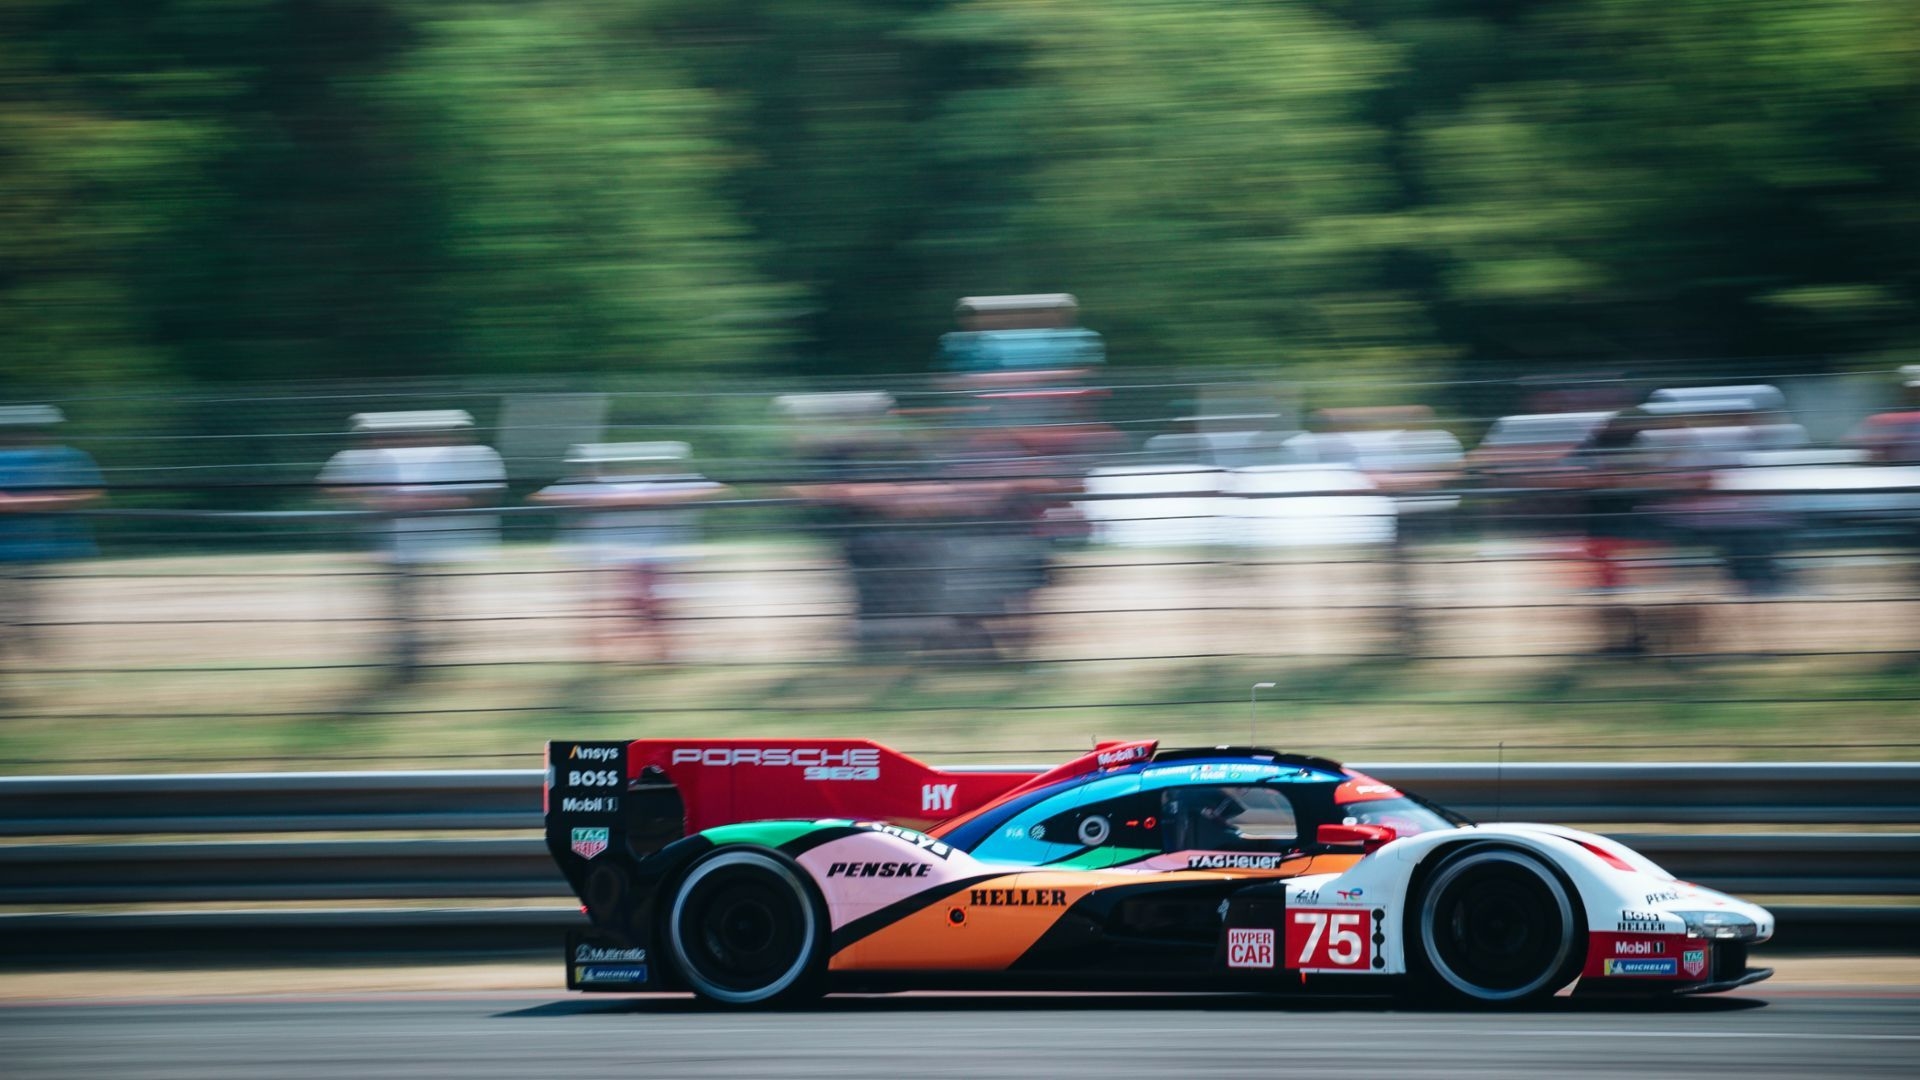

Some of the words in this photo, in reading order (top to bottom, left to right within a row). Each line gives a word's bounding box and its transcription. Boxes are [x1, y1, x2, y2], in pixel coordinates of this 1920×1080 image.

[569, 745, 619, 762] Ansys
[672, 748, 880, 766] PORSCHE
[1098, 749, 1134, 765] Mobil
[568, 770, 619, 787] BOSS
[803, 766, 880, 780] 963
[562, 797, 601, 813] Mobil
[921, 783, 957, 811] HY
[576, 829, 605, 840] TAG
[826, 862, 933, 878] PENSKE
[970, 889, 1067, 906] HELLER
[1617, 922, 1665, 931] HELLER
[1231, 932, 1271, 944] HYPER
[1294, 913, 1362, 965] 75
[1231, 945, 1271, 963] CAR
[1615, 941, 1651, 954] Mobil
[596, 970, 641, 978] MICHELIN
[1625, 963, 1671, 971] MICHELIN
